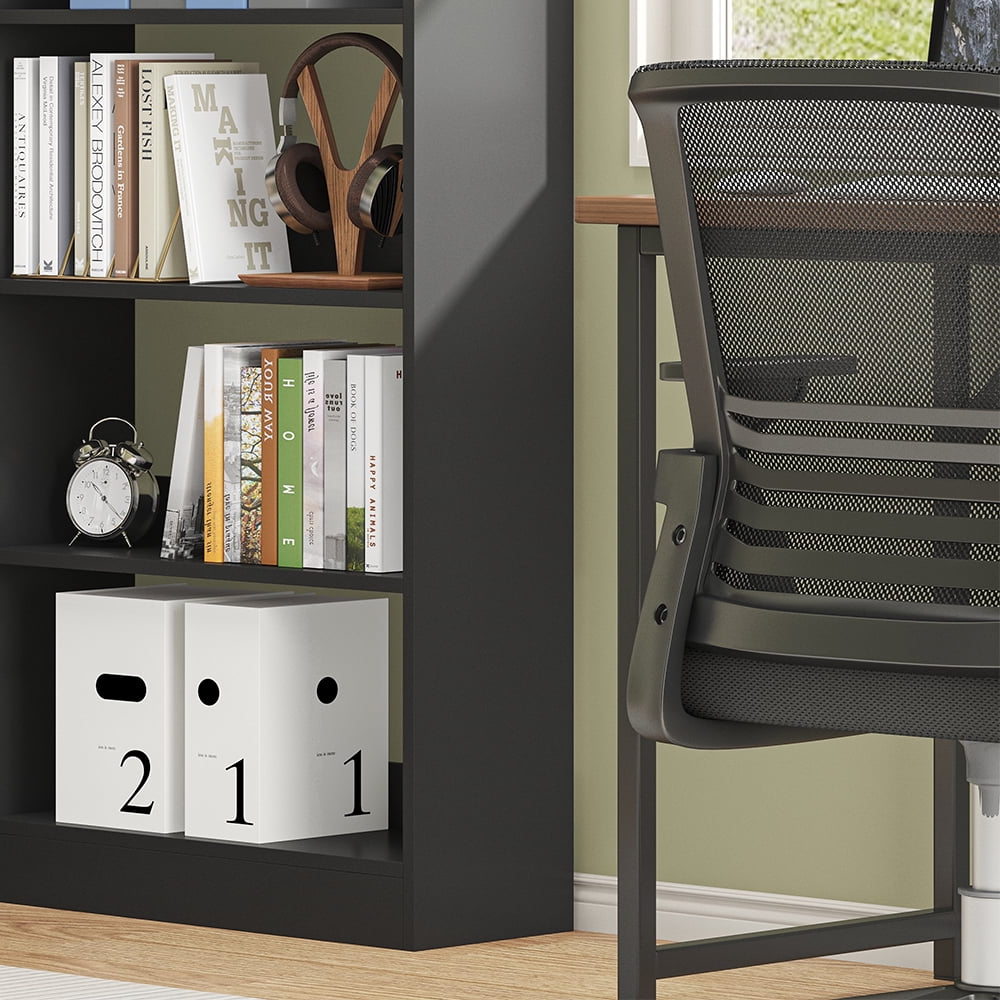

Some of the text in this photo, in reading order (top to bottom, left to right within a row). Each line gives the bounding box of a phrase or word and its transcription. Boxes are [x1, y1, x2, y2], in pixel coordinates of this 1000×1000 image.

[92, 59, 103, 133] ALEXEY
[142, 69, 152, 161] LOST FISH
[166, 85, 182, 152] MAKING IT
[16, 112, 26, 219] ANTIQUAIRES
[117, 125, 125, 168] Gardens
[118, 170, 125, 180] in
[92, 139, 103, 262] BRODOVITCH
[244, 242, 272, 270] IT
[350, 412, 357, 422] OF
[119, 750, 155, 815] 2
[225, 758, 254, 826] 1
[343, 750, 371, 818] 1
